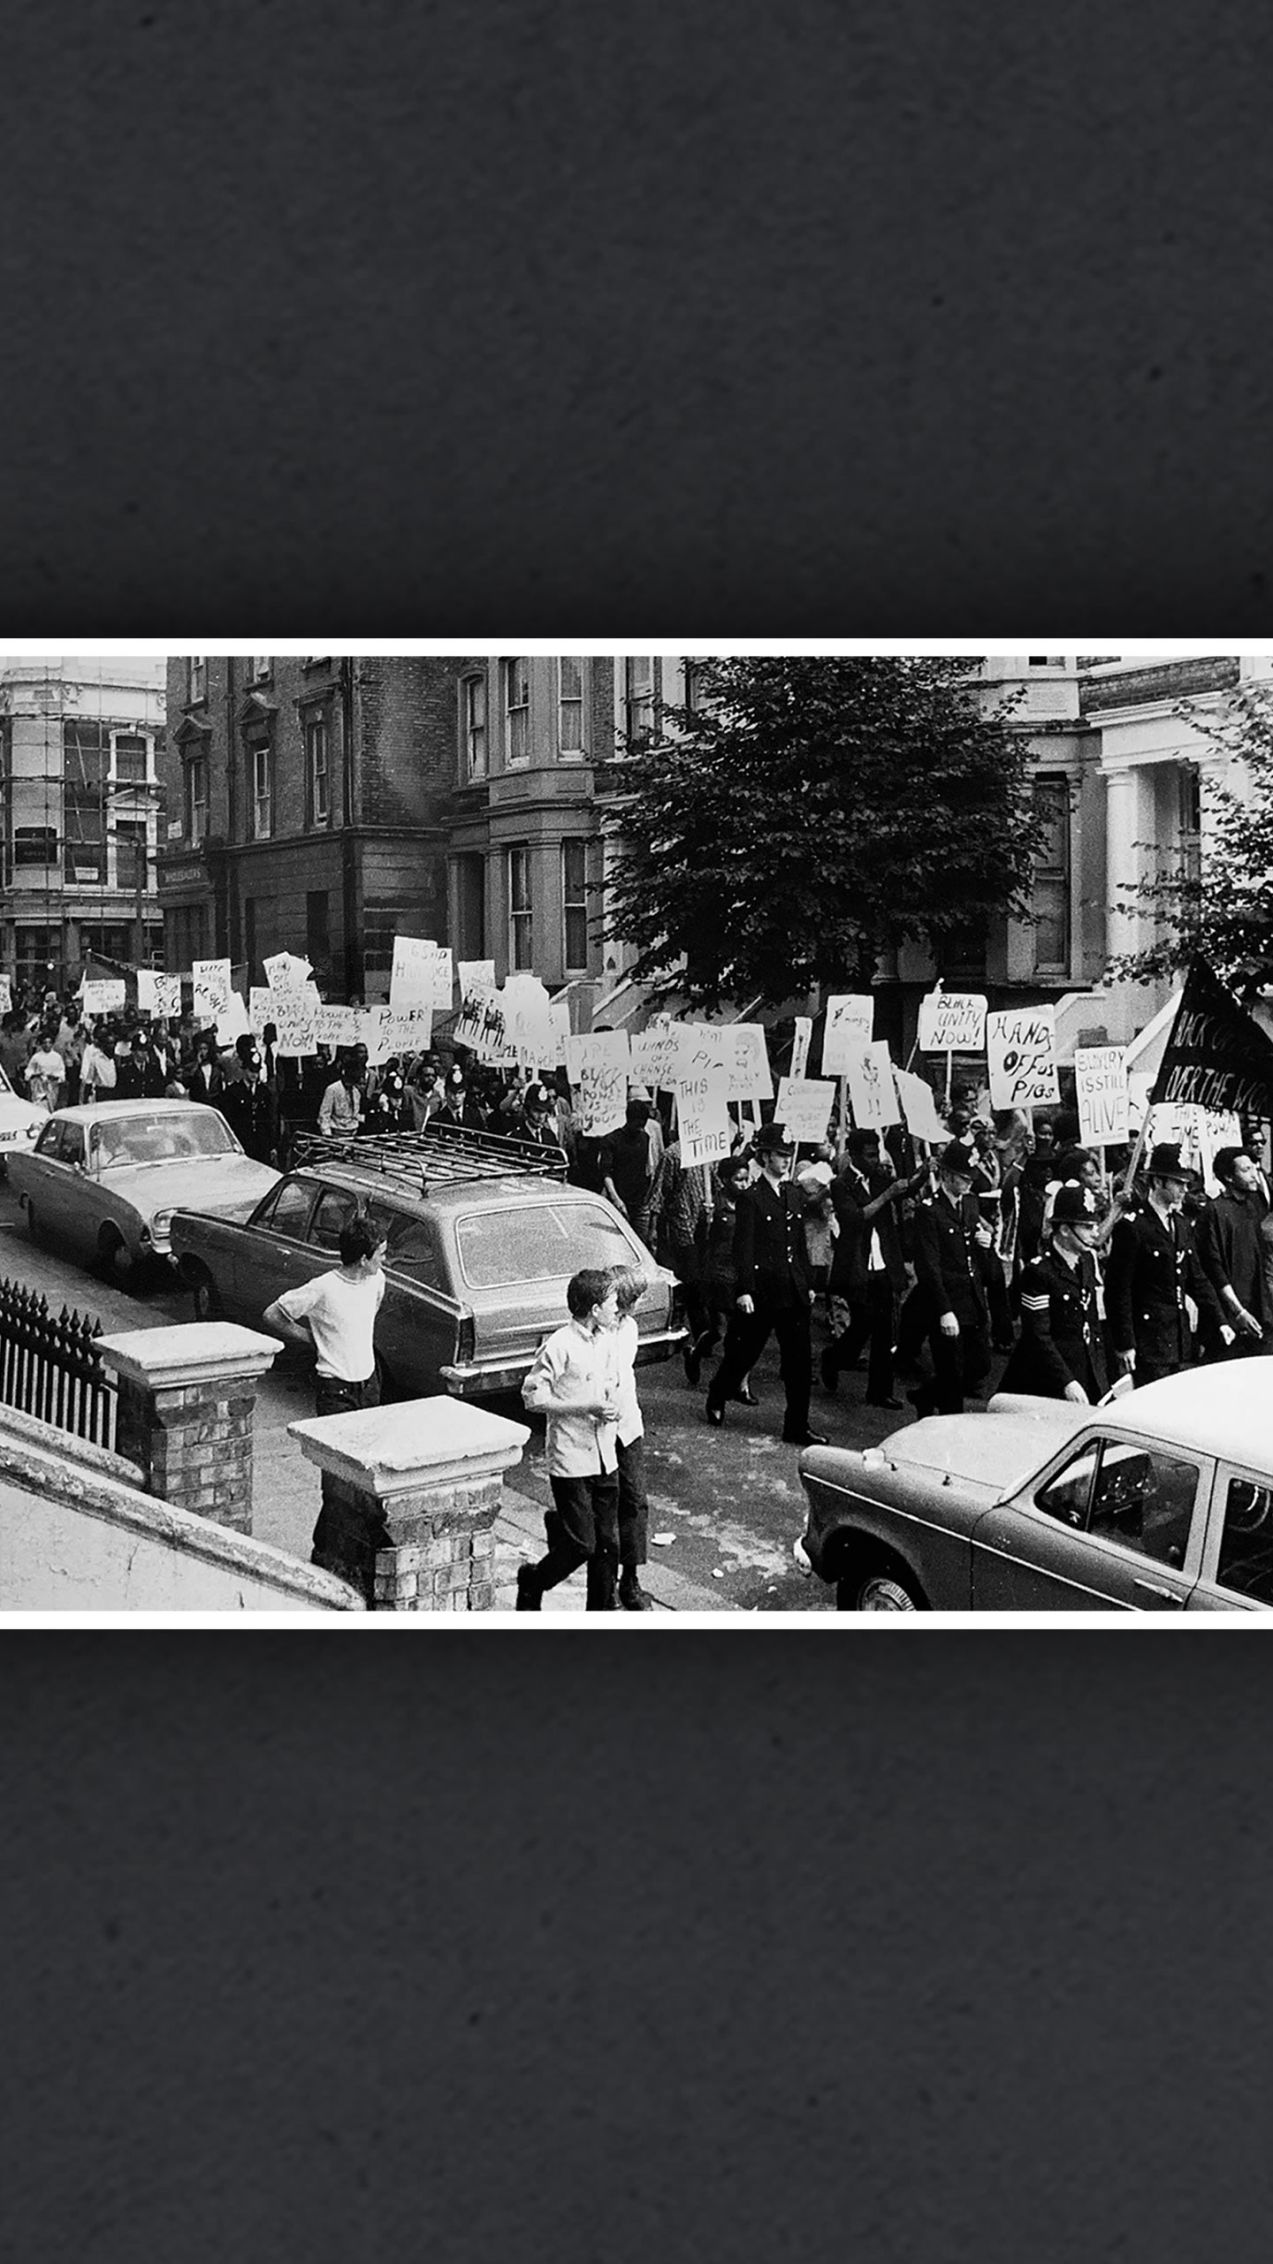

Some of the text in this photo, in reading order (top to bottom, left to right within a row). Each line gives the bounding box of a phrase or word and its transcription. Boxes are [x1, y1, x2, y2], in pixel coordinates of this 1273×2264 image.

[379, 1008, 425, 1025] POWER
[938, 1011, 981, 1028] UNITY
[930, 1027, 980, 1047] NOW!
[992, 1016, 1054, 1053] HANDS
[1003, 1050, 1045, 1078] OFF
[679, 1078, 708, 1099] THIS
[1011, 1080, 1055, 1102] PIGS
[1165, 1065, 1202, 1102] OVER
[1198, 1068, 1235, 1106] THE
[1081, 1095, 1125, 1134] ALIVE
[682, 1118, 702, 1137] THE
[687, 1131, 727, 1158] TIME
